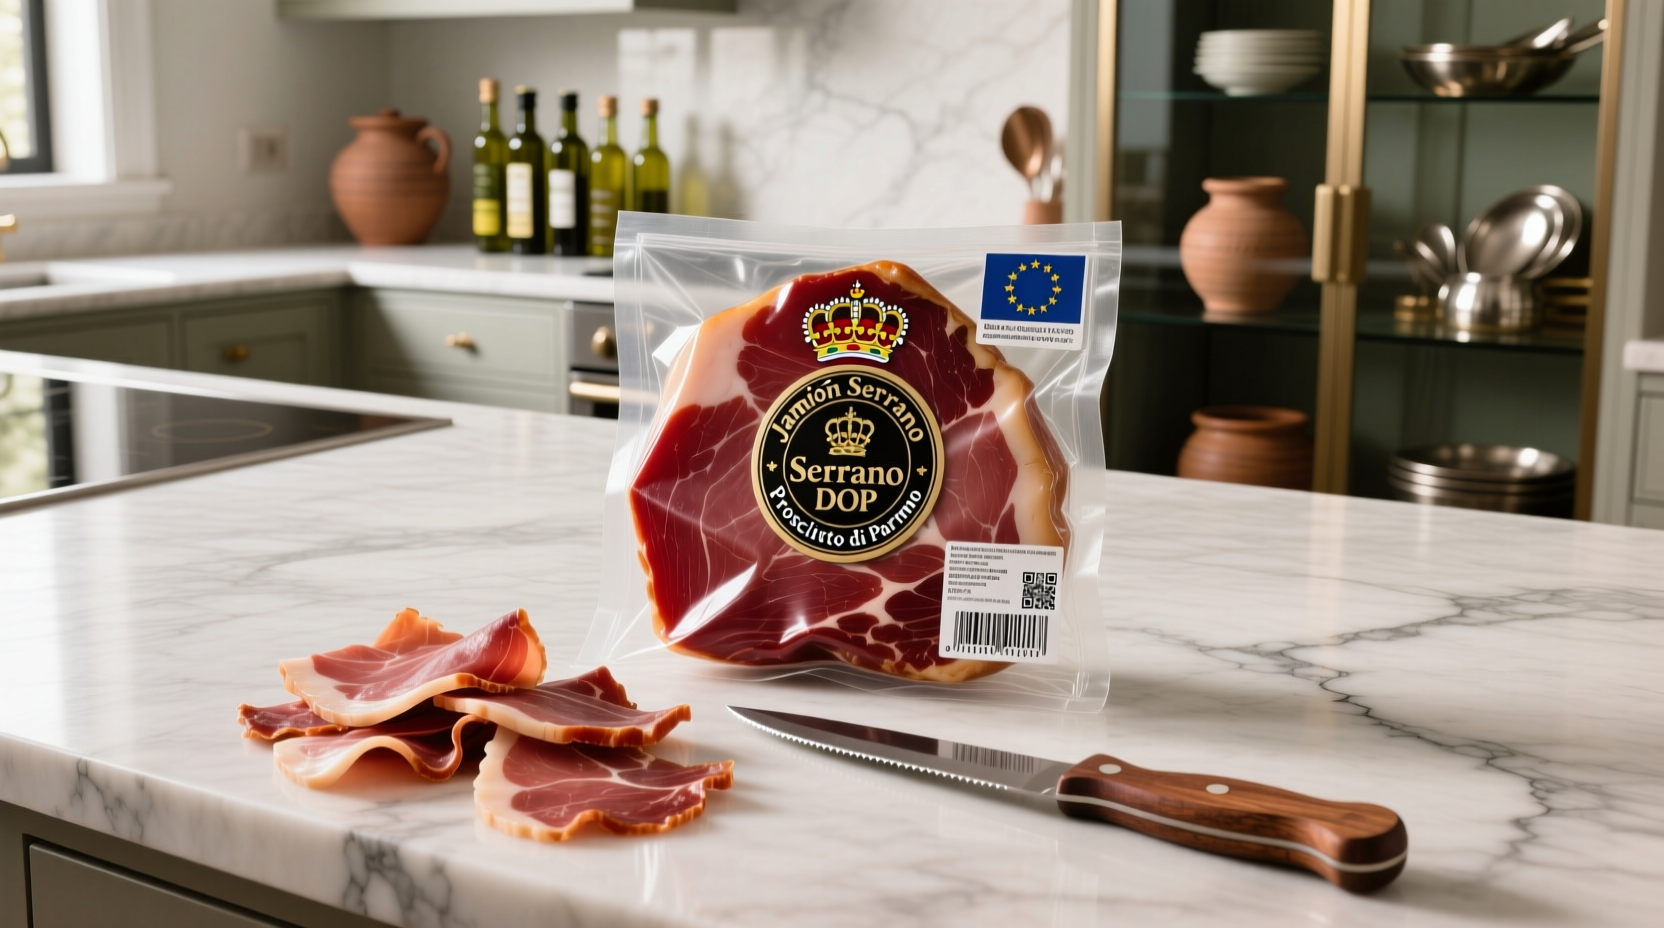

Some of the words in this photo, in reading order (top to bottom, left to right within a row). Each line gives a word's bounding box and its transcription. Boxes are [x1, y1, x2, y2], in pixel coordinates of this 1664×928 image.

[772, 379, 841, 443] Jamión
[847, 376, 924, 442] Serrano
[789, 455, 904, 486] Serrano
[815, 487, 878, 513] DOP
[849, 529, 867, 547] di
